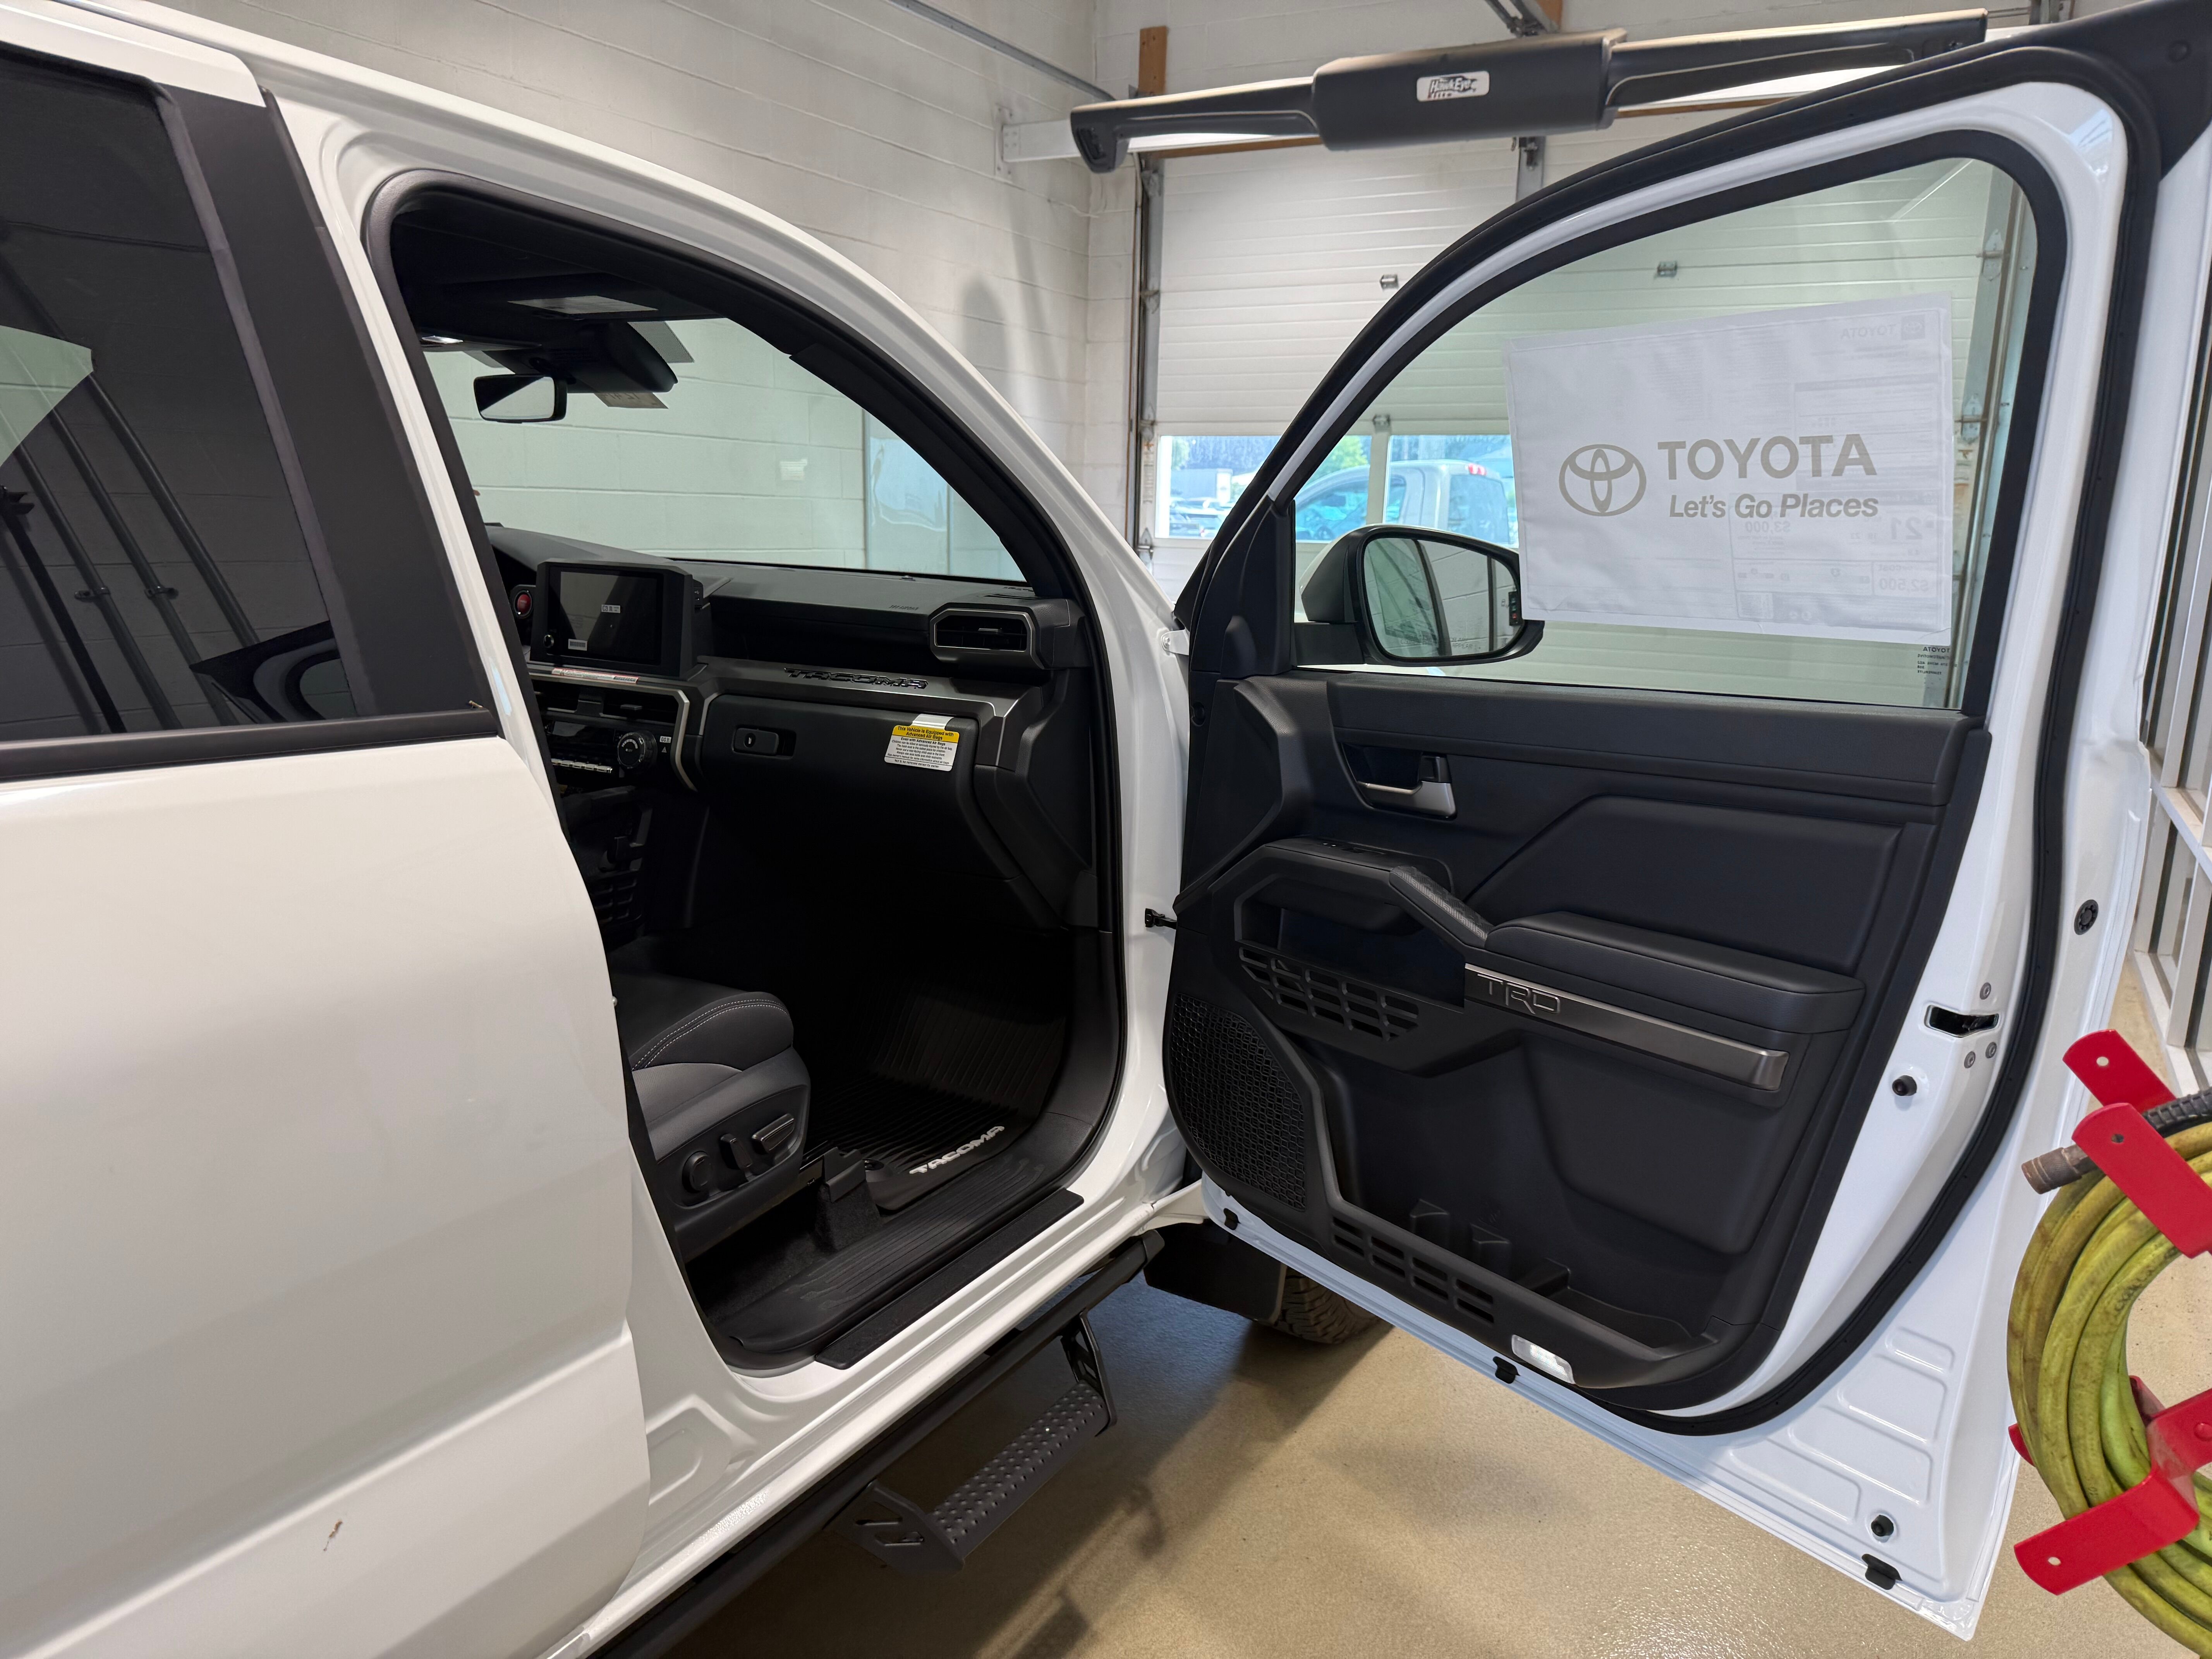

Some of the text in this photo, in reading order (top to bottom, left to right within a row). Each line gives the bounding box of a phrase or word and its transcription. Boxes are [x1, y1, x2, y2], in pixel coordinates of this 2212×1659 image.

[1657, 433, 1877, 481] TOYOTA
[1669, 492, 1880, 519] Let's Go Places
[784, 666, 929, 689] TACOMA
[1477, 973, 1561, 1014] TRD
[909, 1126, 1005, 1174] TACOMA
